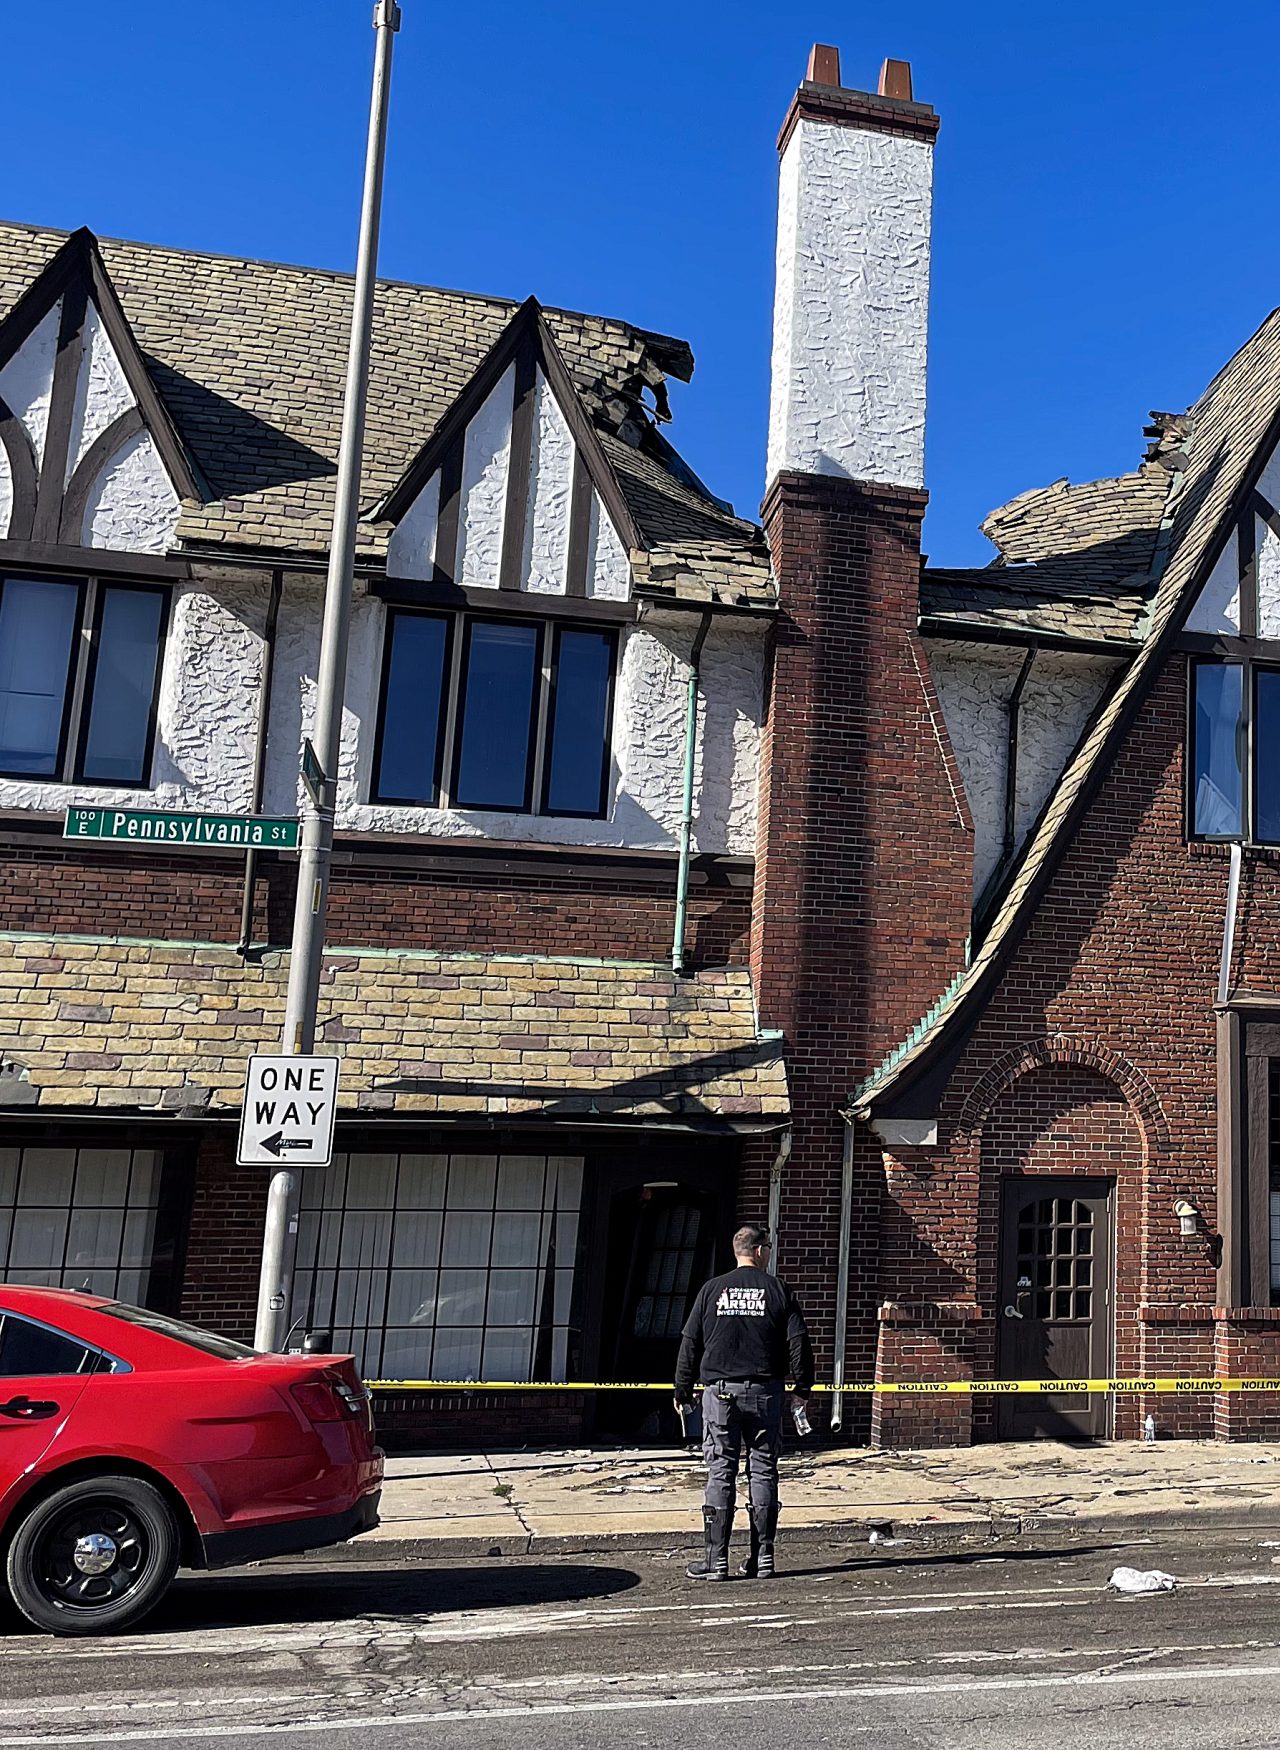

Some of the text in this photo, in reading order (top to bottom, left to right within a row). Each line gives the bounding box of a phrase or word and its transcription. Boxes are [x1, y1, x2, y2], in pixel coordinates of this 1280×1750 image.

[74, 810, 96, 821] 100
[78, 822, 88, 834] E
[112, 812, 287, 842] Pennsylvania St
[260, 1068, 325, 1092] ONE
[255, 1102, 325, 1126] WAY
[717, 1292, 765, 1310] ARSON
[824, 1383, 875, 1391] CAUTION
[898, 1383, 948, 1391] CAUTION
[970, 1383, 1019, 1391] CAUTION
[1040, 1382, 1088, 1391] CAUTION
[1108, 1381, 1156, 1391] CAUTION
[1175, 1381, 1222, 1390] CAUTION
